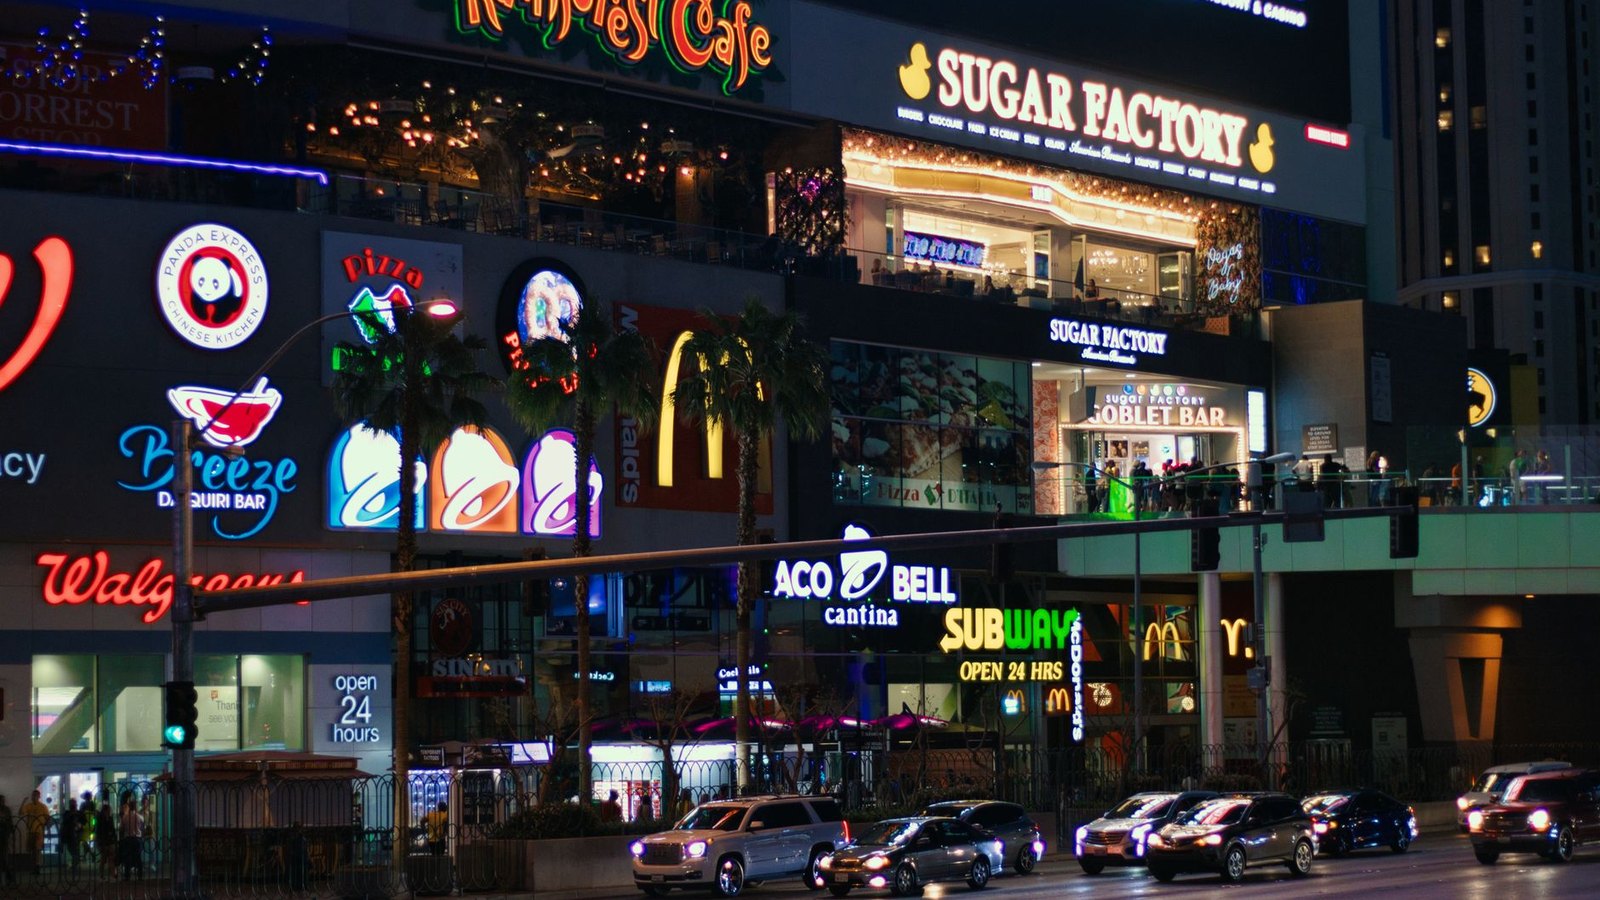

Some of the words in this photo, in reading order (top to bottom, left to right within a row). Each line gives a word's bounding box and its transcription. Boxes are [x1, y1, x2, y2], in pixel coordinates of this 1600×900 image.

[1263, 3, 1307, 28] CASINO
[671, 0, 771, 88] Cafe
[12, 58, 101, 95] STOP
[937, 47, 1077, 132] SUGAR
[1082, 81, 1248, 167] FACTORY
[164, 232, 205, 277] PANDA
[210, 229, 263, 285] EXPRESS
[167, 299, 211, 344] CHINESE
[215, 307, 259, 344] KITCHEN
[1050, 318, 1100, 347] SUGAR
[1102, 325, 1167, 354] FACTORY
[1105, 395, 1144, 406] sugar
[1150, 396, 1205, 405] FACTORY
[1179, 406, 1225, 426] BAR
[0, 453, 45, 484] cy
[117, 425, 298, 539] Breeze
[158, 491, 230, 509] DQUIRI
[235, 493, 266, 510] BAR
[877, 481, 920, 502] Pizza
[37, 551, 310, 622] Walgee
[893, 565, 957, 603] BELL
[825, 604, 899, 627] cantina
[940, 606, 1079, 653] SUBWAY
[335, 674, 378, 693] open
[718, 665, 760, 679] Cocils
[959, 661, 1003, 681] OPEN
[1007, 661, 1026, 681] 24
[1030, 661, 1063, 681] HRS
[340, 695, 373, 725] 24
[333, 724, 380, 743] hours
